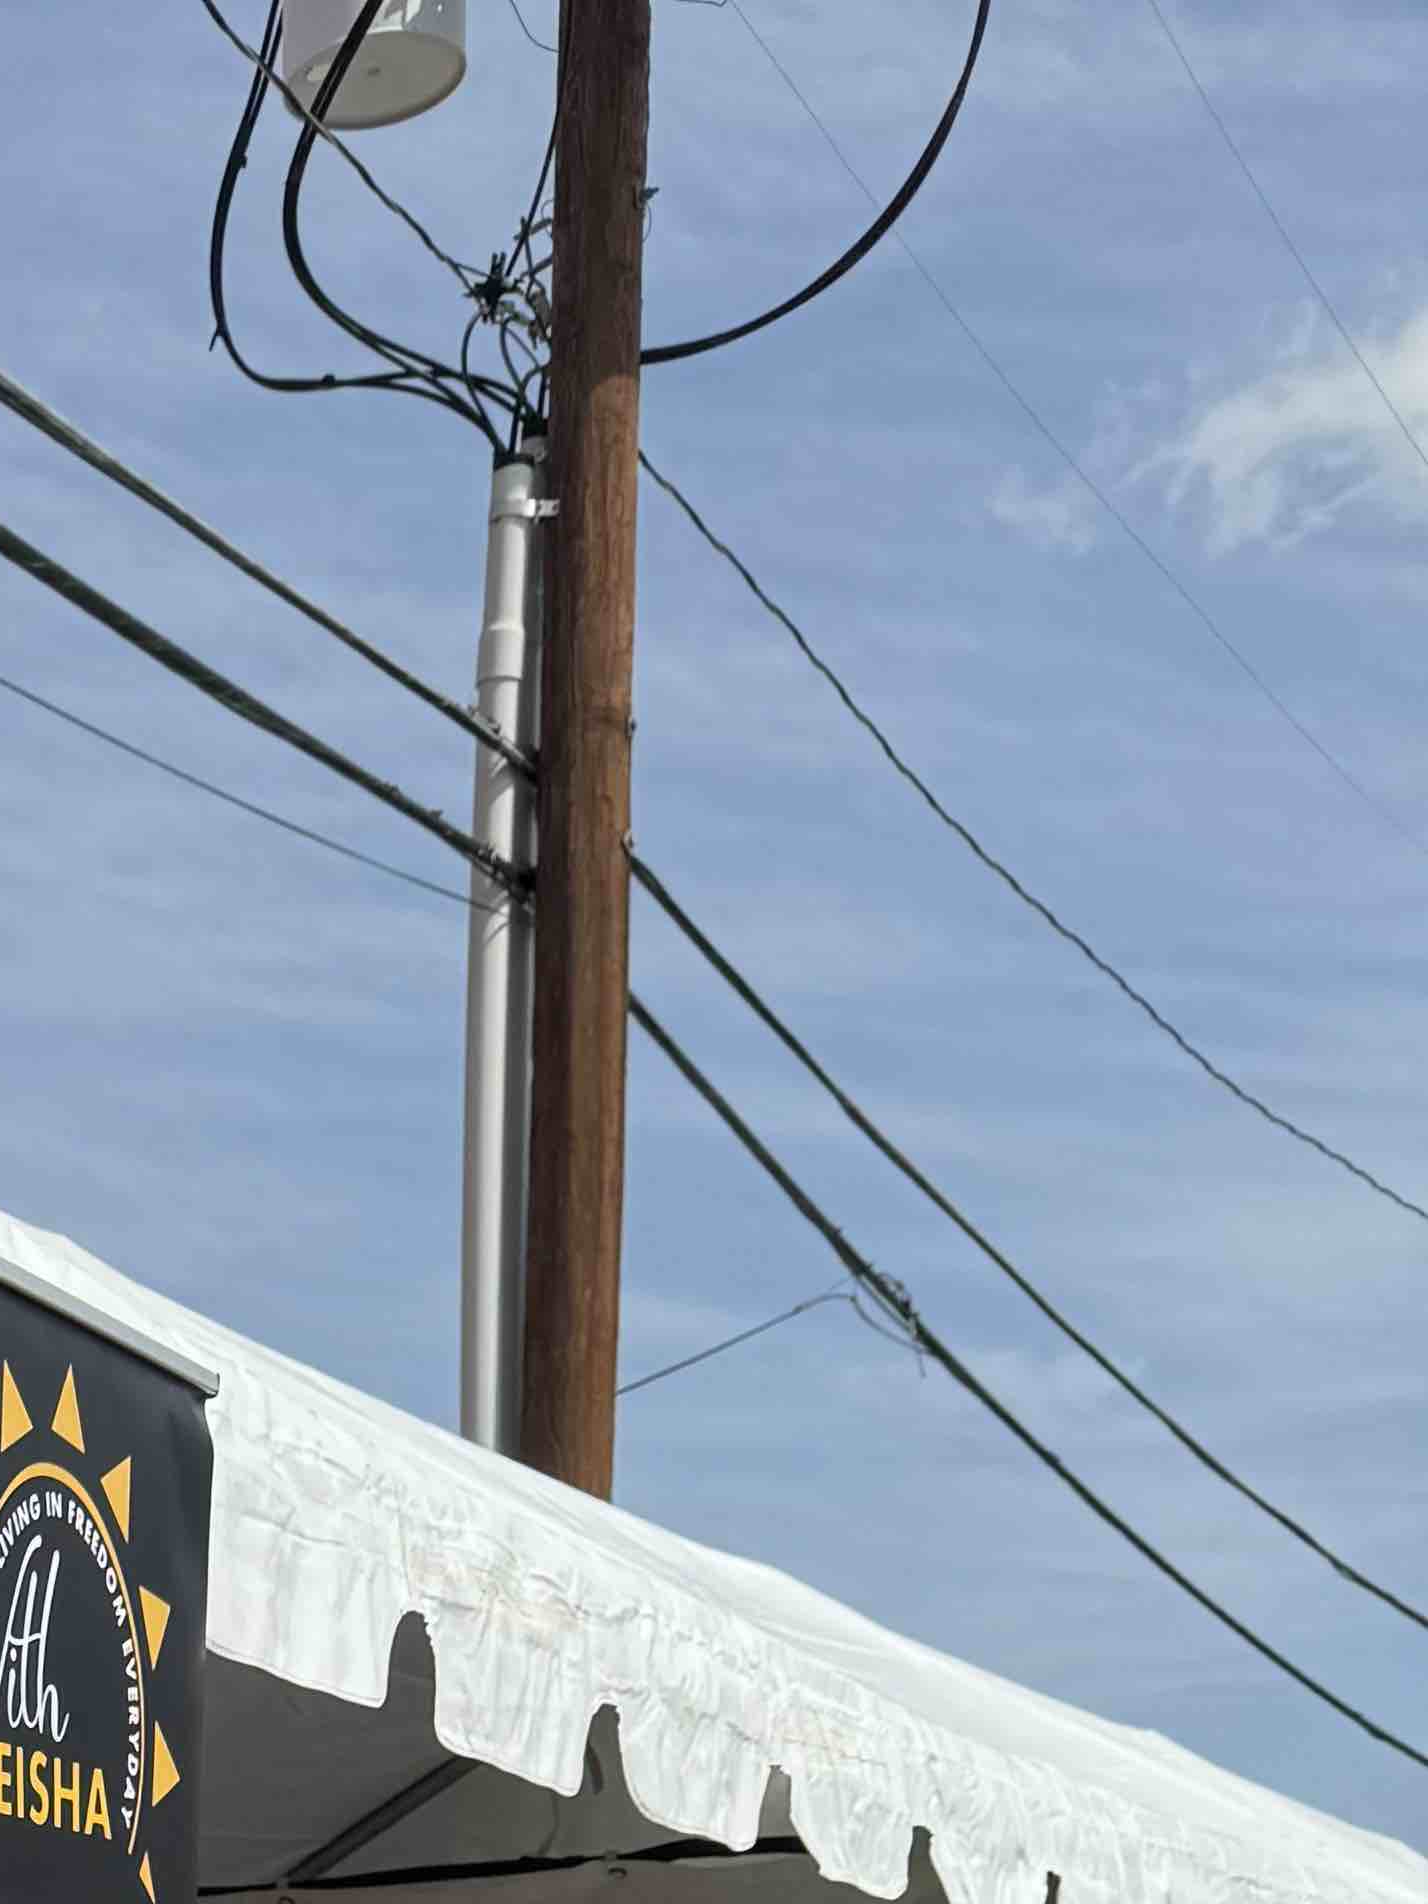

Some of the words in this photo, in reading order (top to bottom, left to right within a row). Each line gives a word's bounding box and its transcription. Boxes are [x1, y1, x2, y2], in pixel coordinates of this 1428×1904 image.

[45, 1491, 63, 1518] IN
[68, 1500, 127, 1627] FREEDOM
[121, 1637, 140, 1829] EVERYDAY
